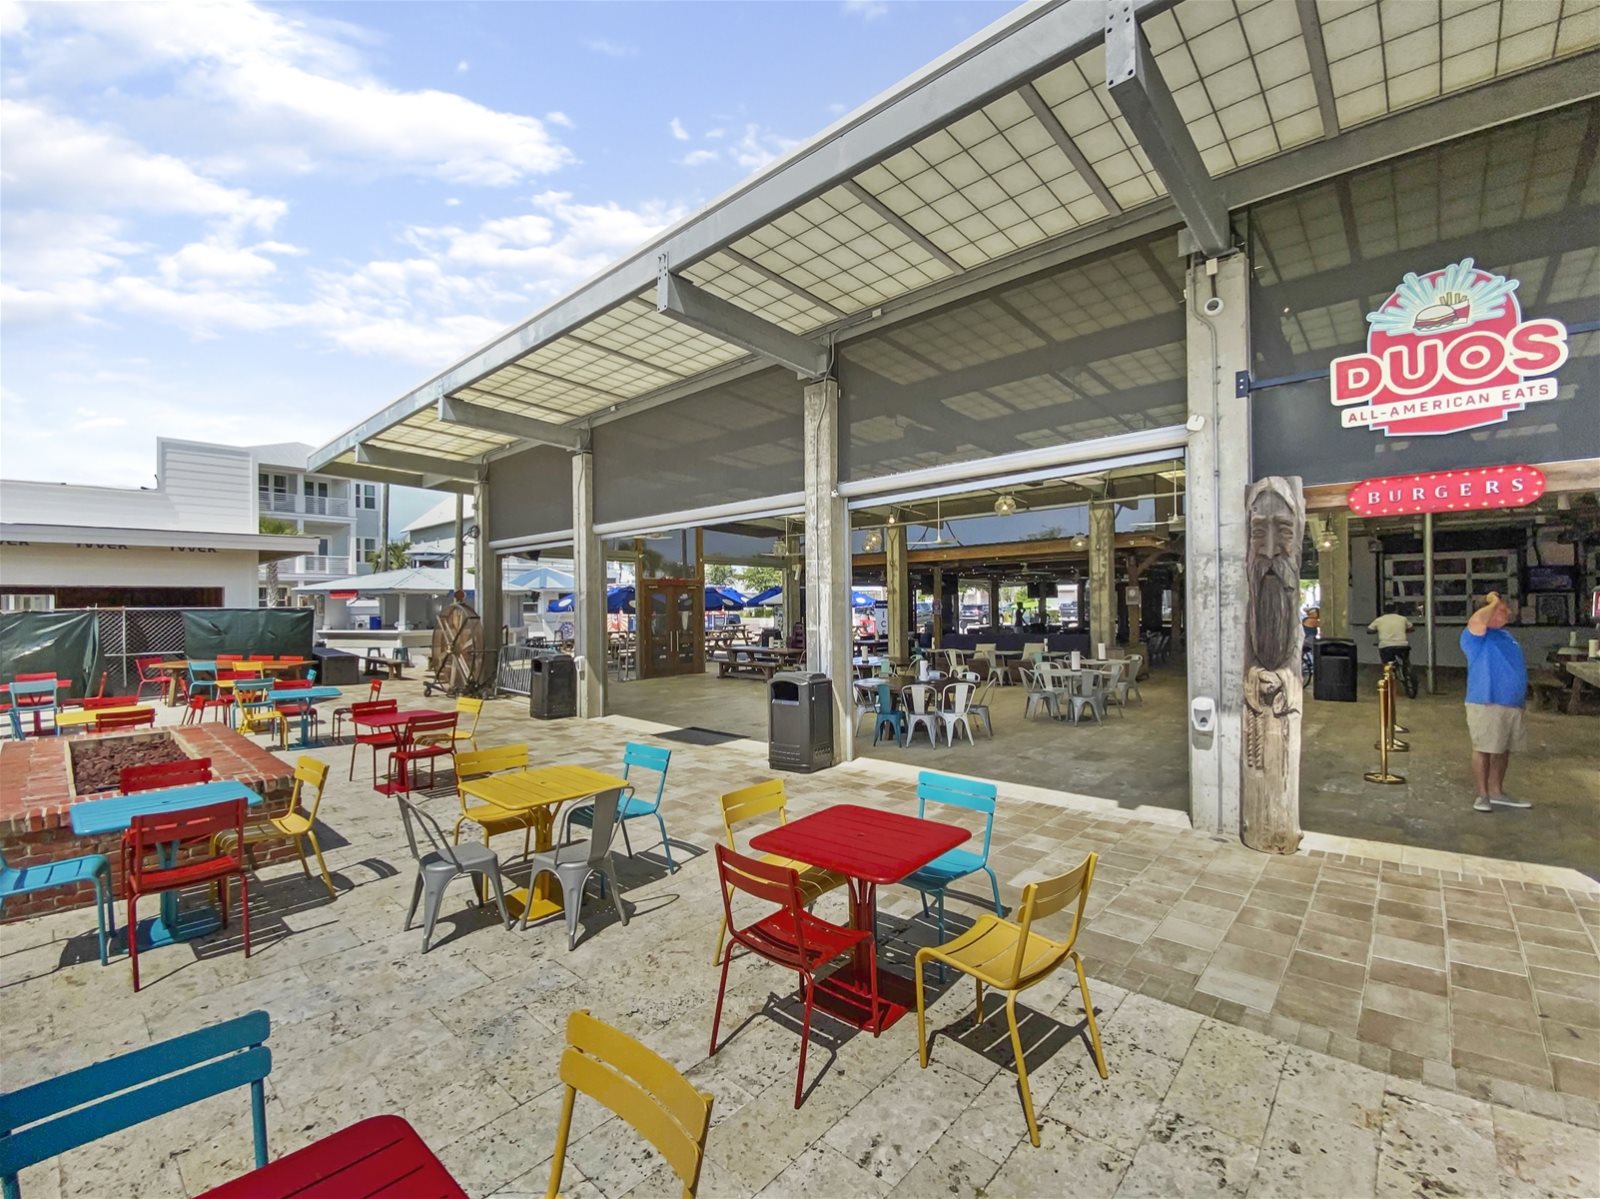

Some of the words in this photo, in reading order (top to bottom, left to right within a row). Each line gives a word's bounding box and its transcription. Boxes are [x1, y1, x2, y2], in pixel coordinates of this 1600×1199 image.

[1333, 321, 1566, 403] DUOS
[1348, 393, 1490, 423] ALL-AMERICAN
[1502, 384, 1550, 401] EATS
[1368, 478, 1524, 505] BURGERS
